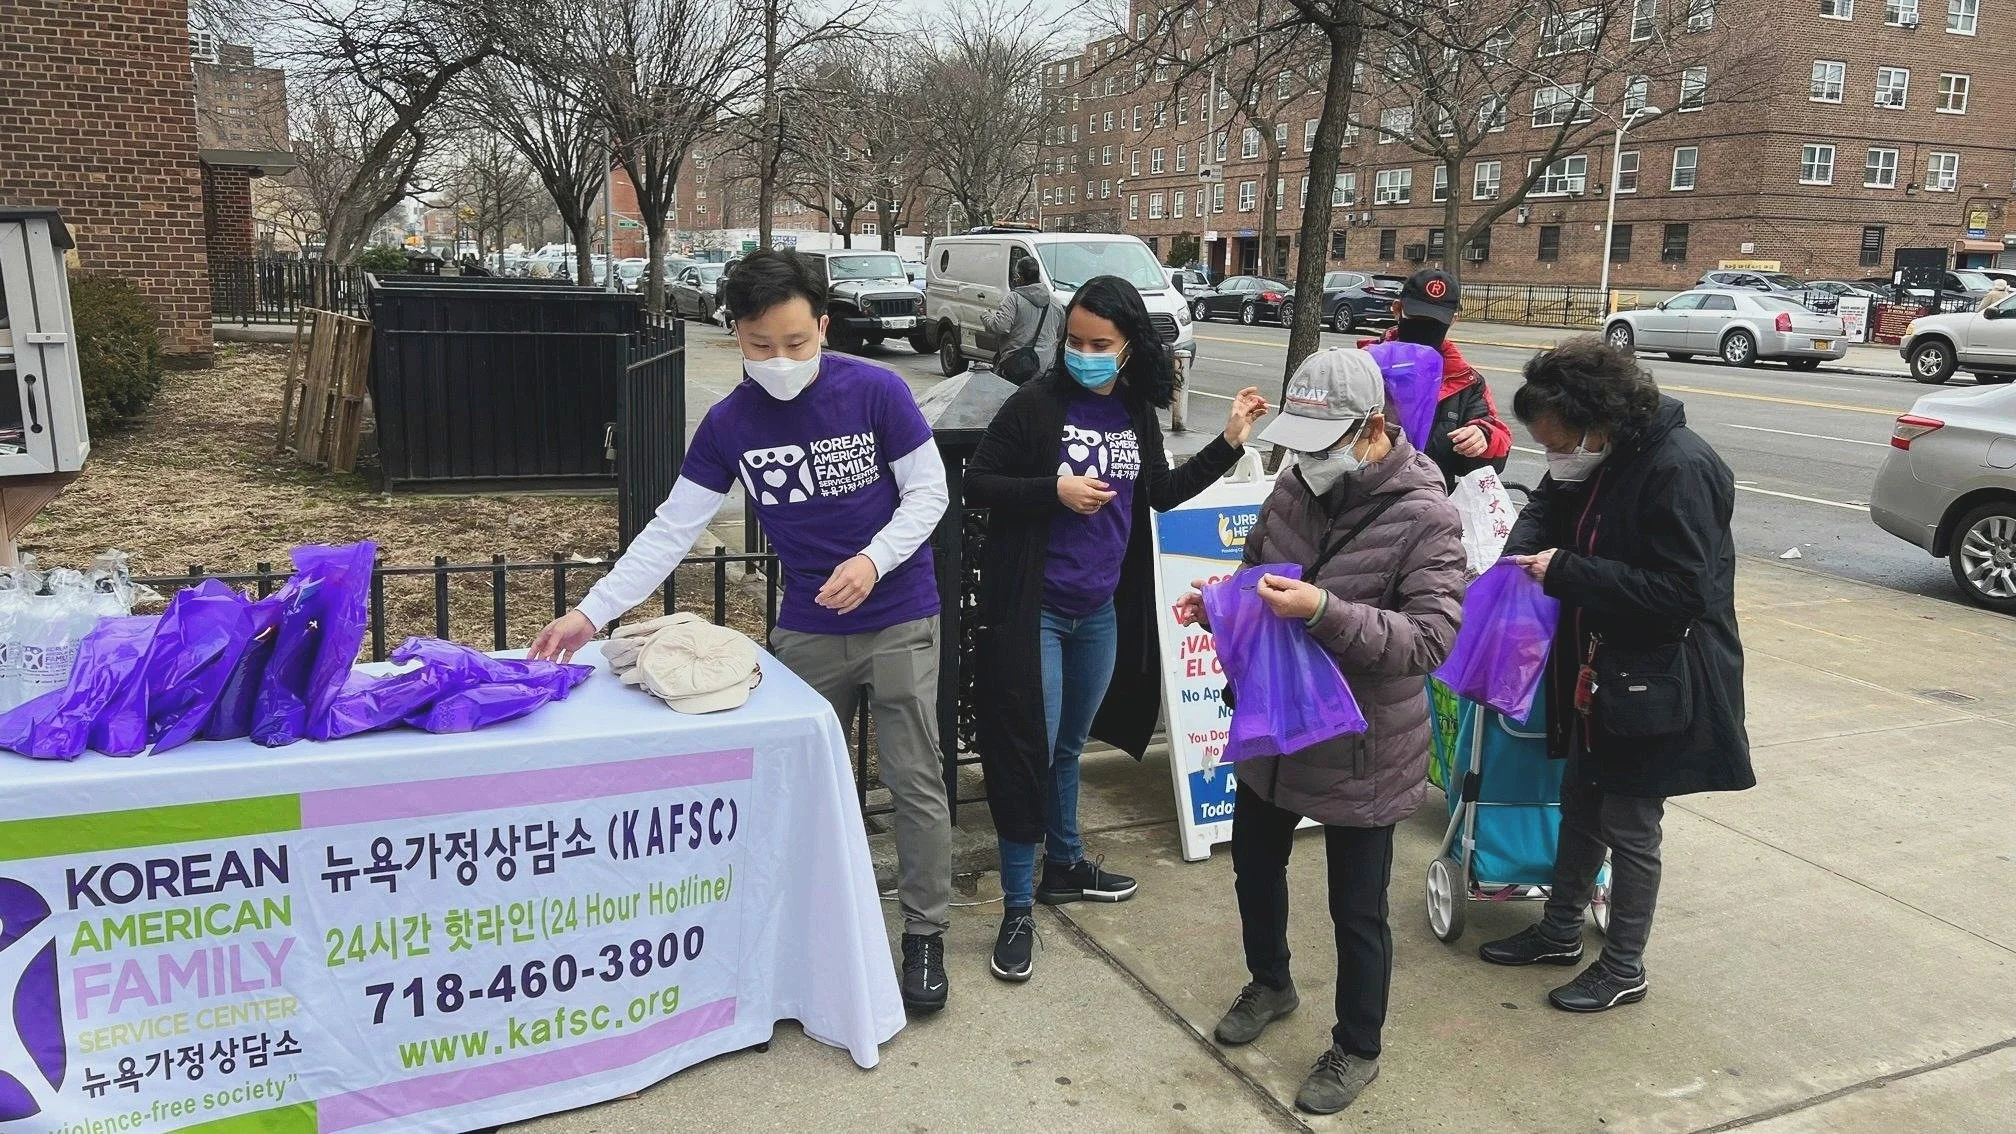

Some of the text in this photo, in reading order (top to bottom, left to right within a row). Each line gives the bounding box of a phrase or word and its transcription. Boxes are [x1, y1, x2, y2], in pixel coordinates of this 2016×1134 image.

[810, 432, 875, 454] KOREAN
[813, 445, 875, 465] AMERICAN
[815, 452, 876, 480] FAMILY
[819, 465, 878, 487] SERVICE CENTER
[821, 473, 880, 497] 뉴욕가정상담소
[1232, 514, 1257, 526] URB
[1186, 659, 1206, 678] EL
[1182, 690, 1199, 703] No
[1188, 733, 1207, 744] You
[1205, 746, 1219, 757] No
[320, 798, 738, 893] 뉴욕가정상담소 (KAFSC)
[65, 845, 290, 910] KOREAN
[70, 895, 292, 956] AMERICAN
[326, 912, 432, 968] 24시간
[586, 891, 640, 929] Hour
[649, 864, 733, 917] Hotline)
[73, 937, 296, 1019] FAMILY
[365, 925, 705, 1024] 718-460-3800
[78, 996, 301, 1054] SERVICE CENTER
[399, 984, 680, 1070] www.kafsc.org
[82, 1030, 302, 1098] 뉴욕가정상담소
[49, 1098, 196, 1134] iolence-free
